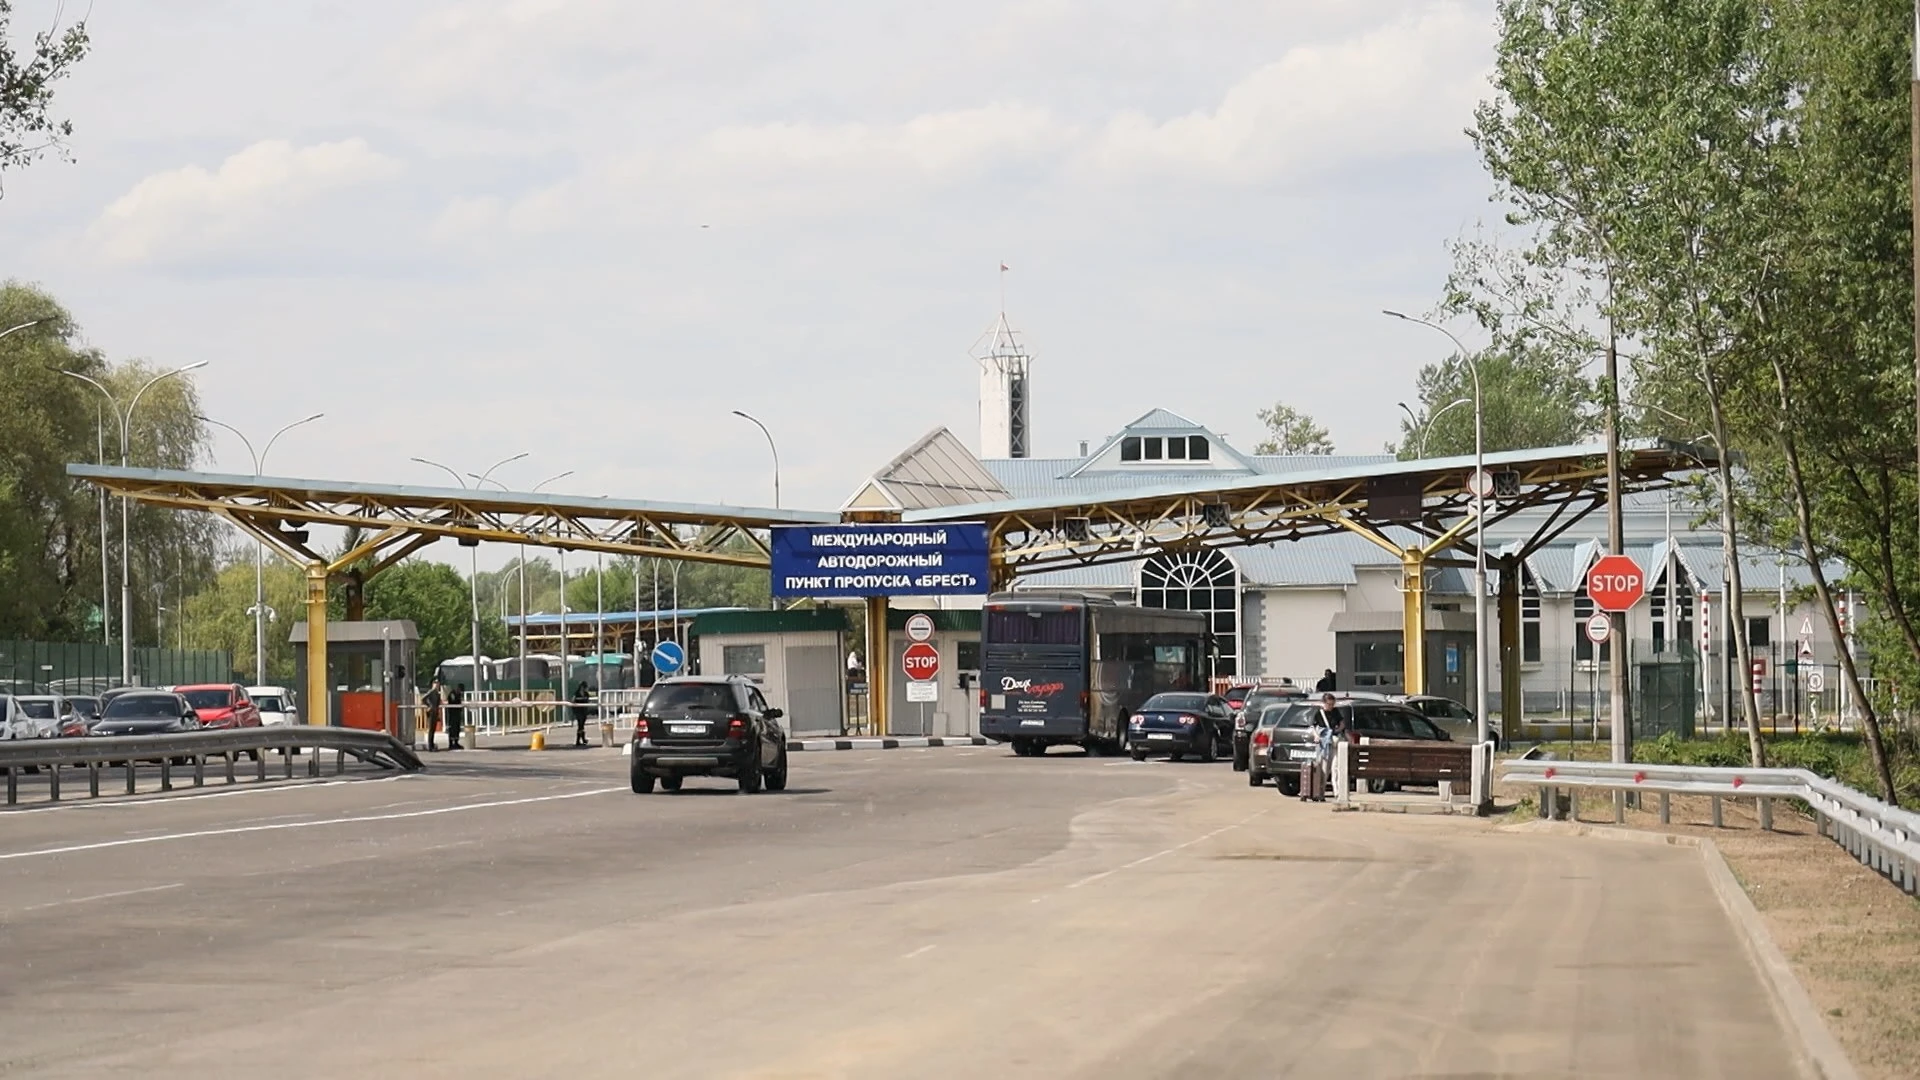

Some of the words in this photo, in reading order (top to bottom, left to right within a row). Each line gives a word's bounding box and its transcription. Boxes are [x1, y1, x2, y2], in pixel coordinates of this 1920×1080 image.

[812, 530, 947, 548] МЕЖДУНАРОДНЫЙ
[818, 552, 943, 569] АВТОДОРОЖНЫЙ
[785, 576, 831, 589] ПУНКТ
[835, 575, 911, 588] ПРОПУСКА
[915, 574, 977, 587] «БРЕСТ»
[1592, 575, 1639, 592] STOP
[906, 656, 937, 668] STOP
